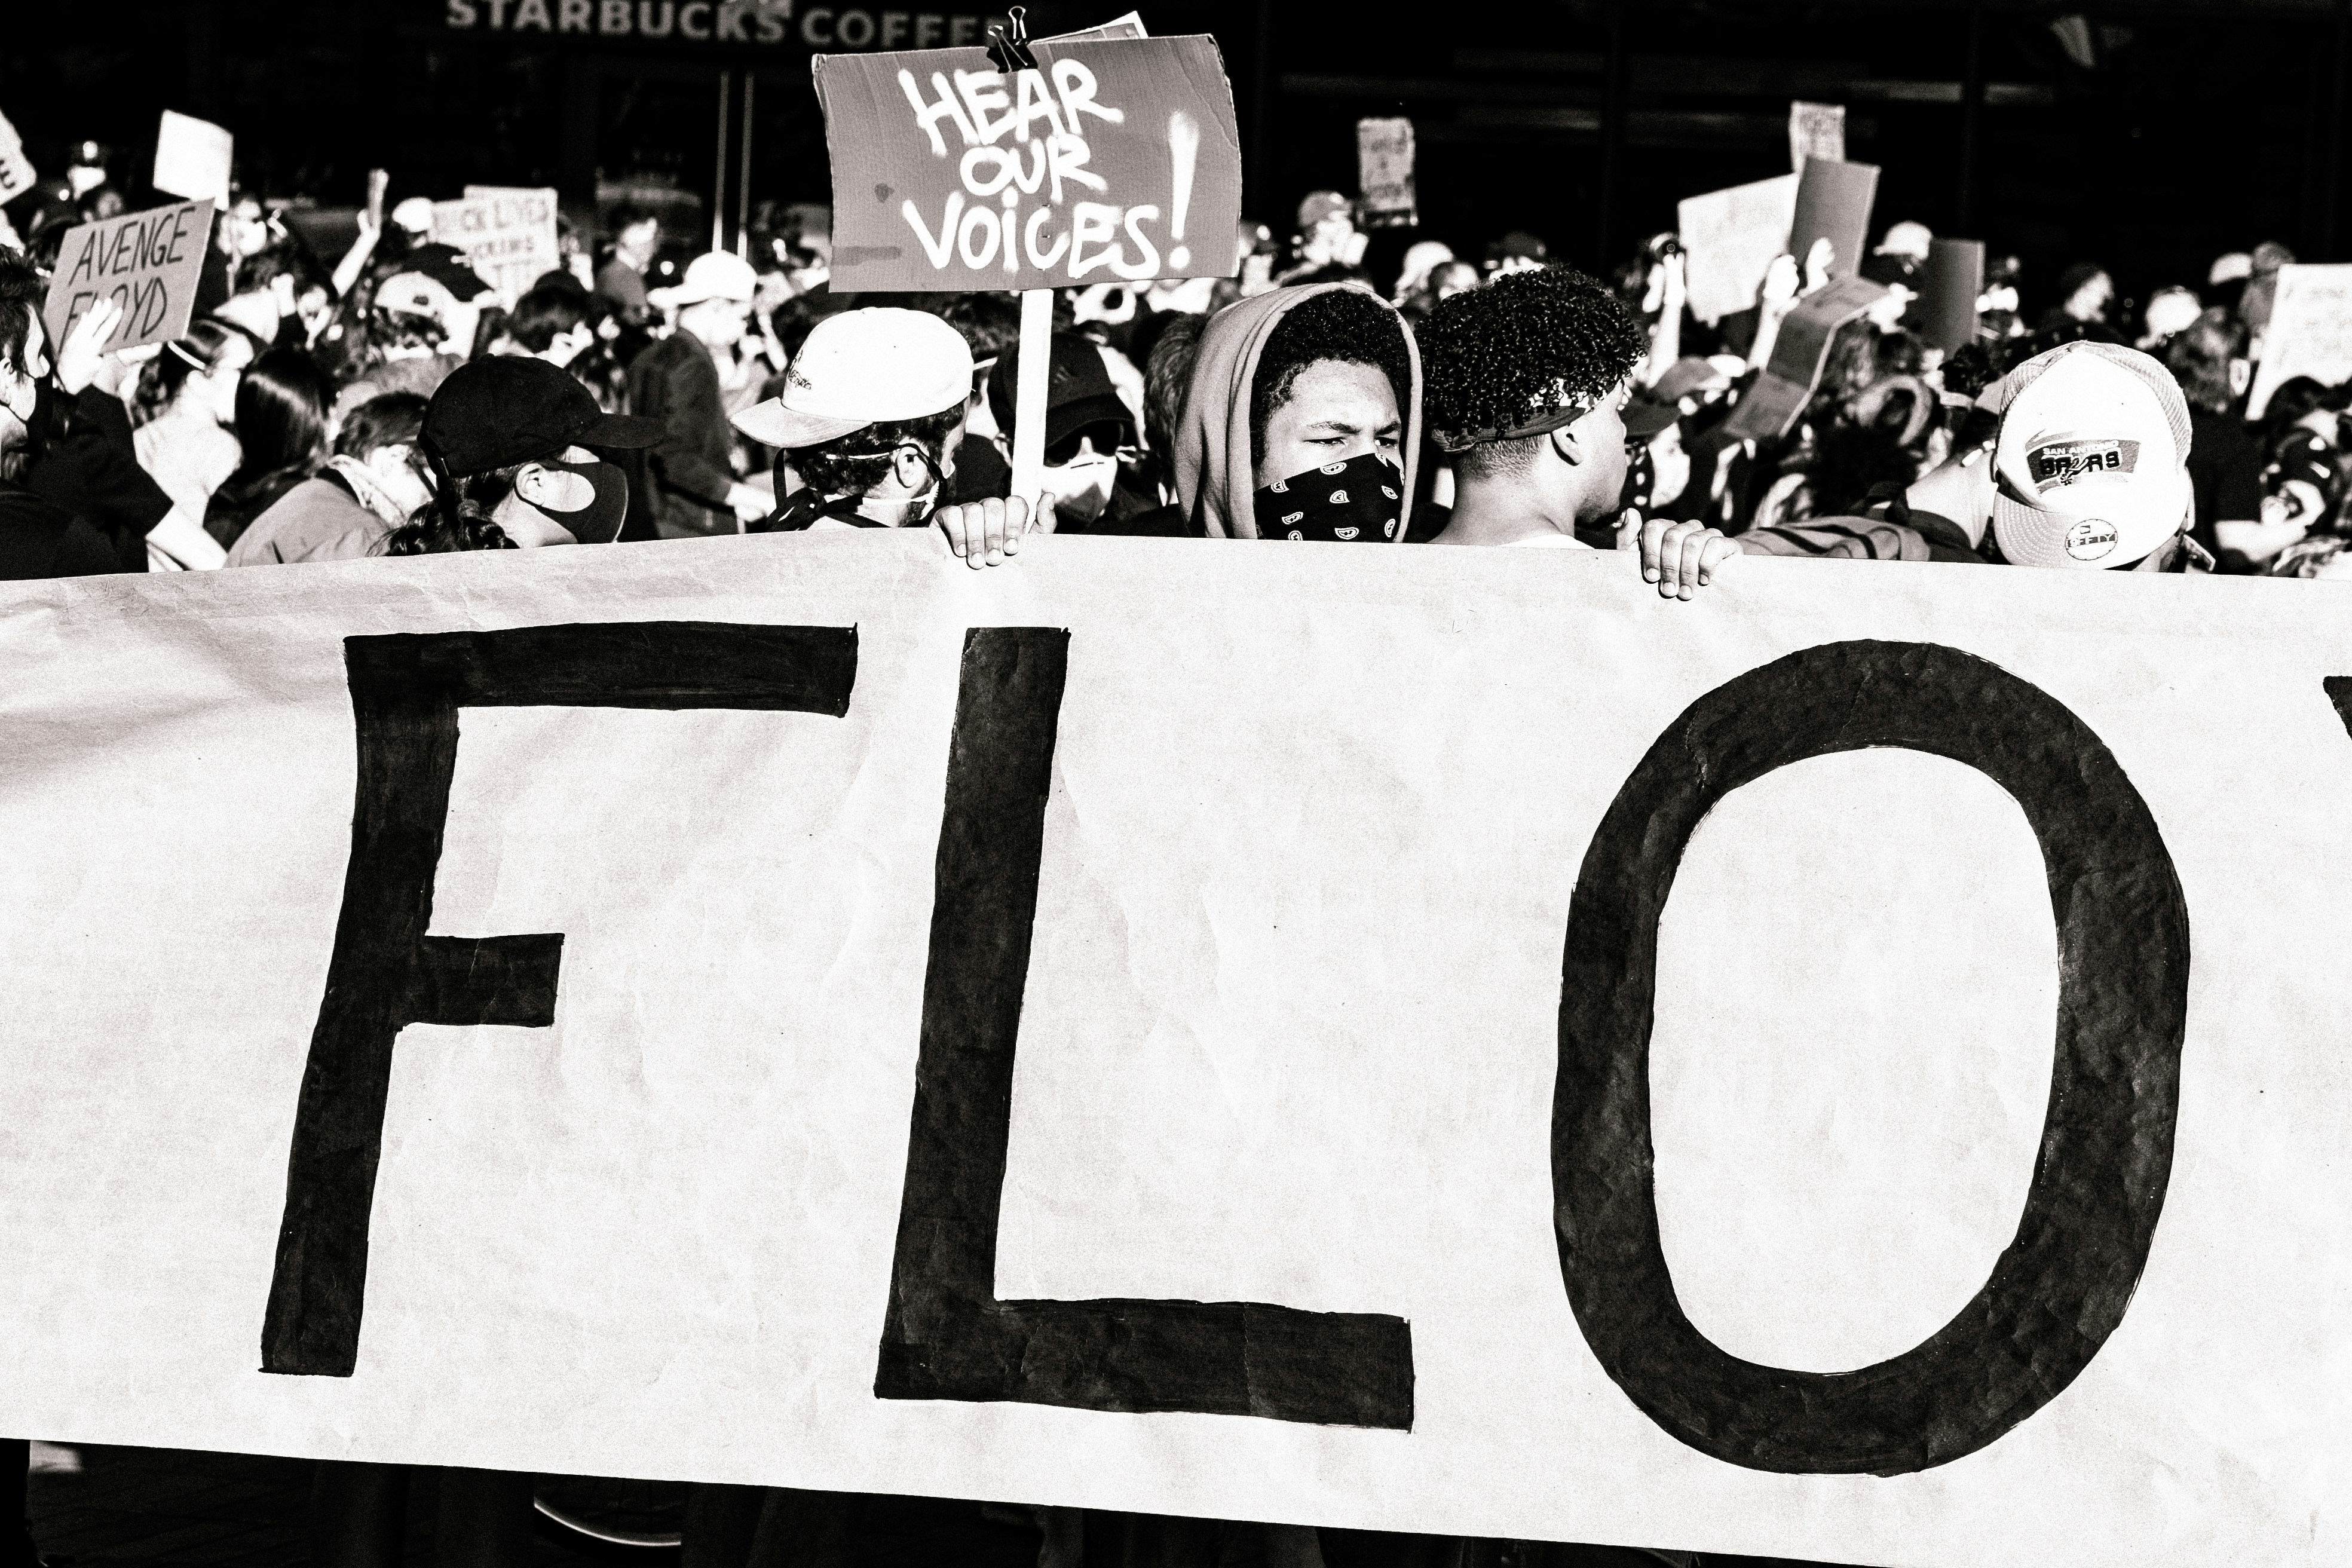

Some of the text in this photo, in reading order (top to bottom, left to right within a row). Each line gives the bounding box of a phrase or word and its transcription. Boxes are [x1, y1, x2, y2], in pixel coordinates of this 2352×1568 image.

[447, 0, 786, 42] STARBUCKS
[898, 59, 1125, 157] HEAR
[960, 133, 1109, 204] OUR
[68, 206, 195, 287] AVENGE
[58, 277, 167, 358] FOYD
[2042, 447, 2066, 455] SAN
[259, 621, 2352, 1477] FLO
